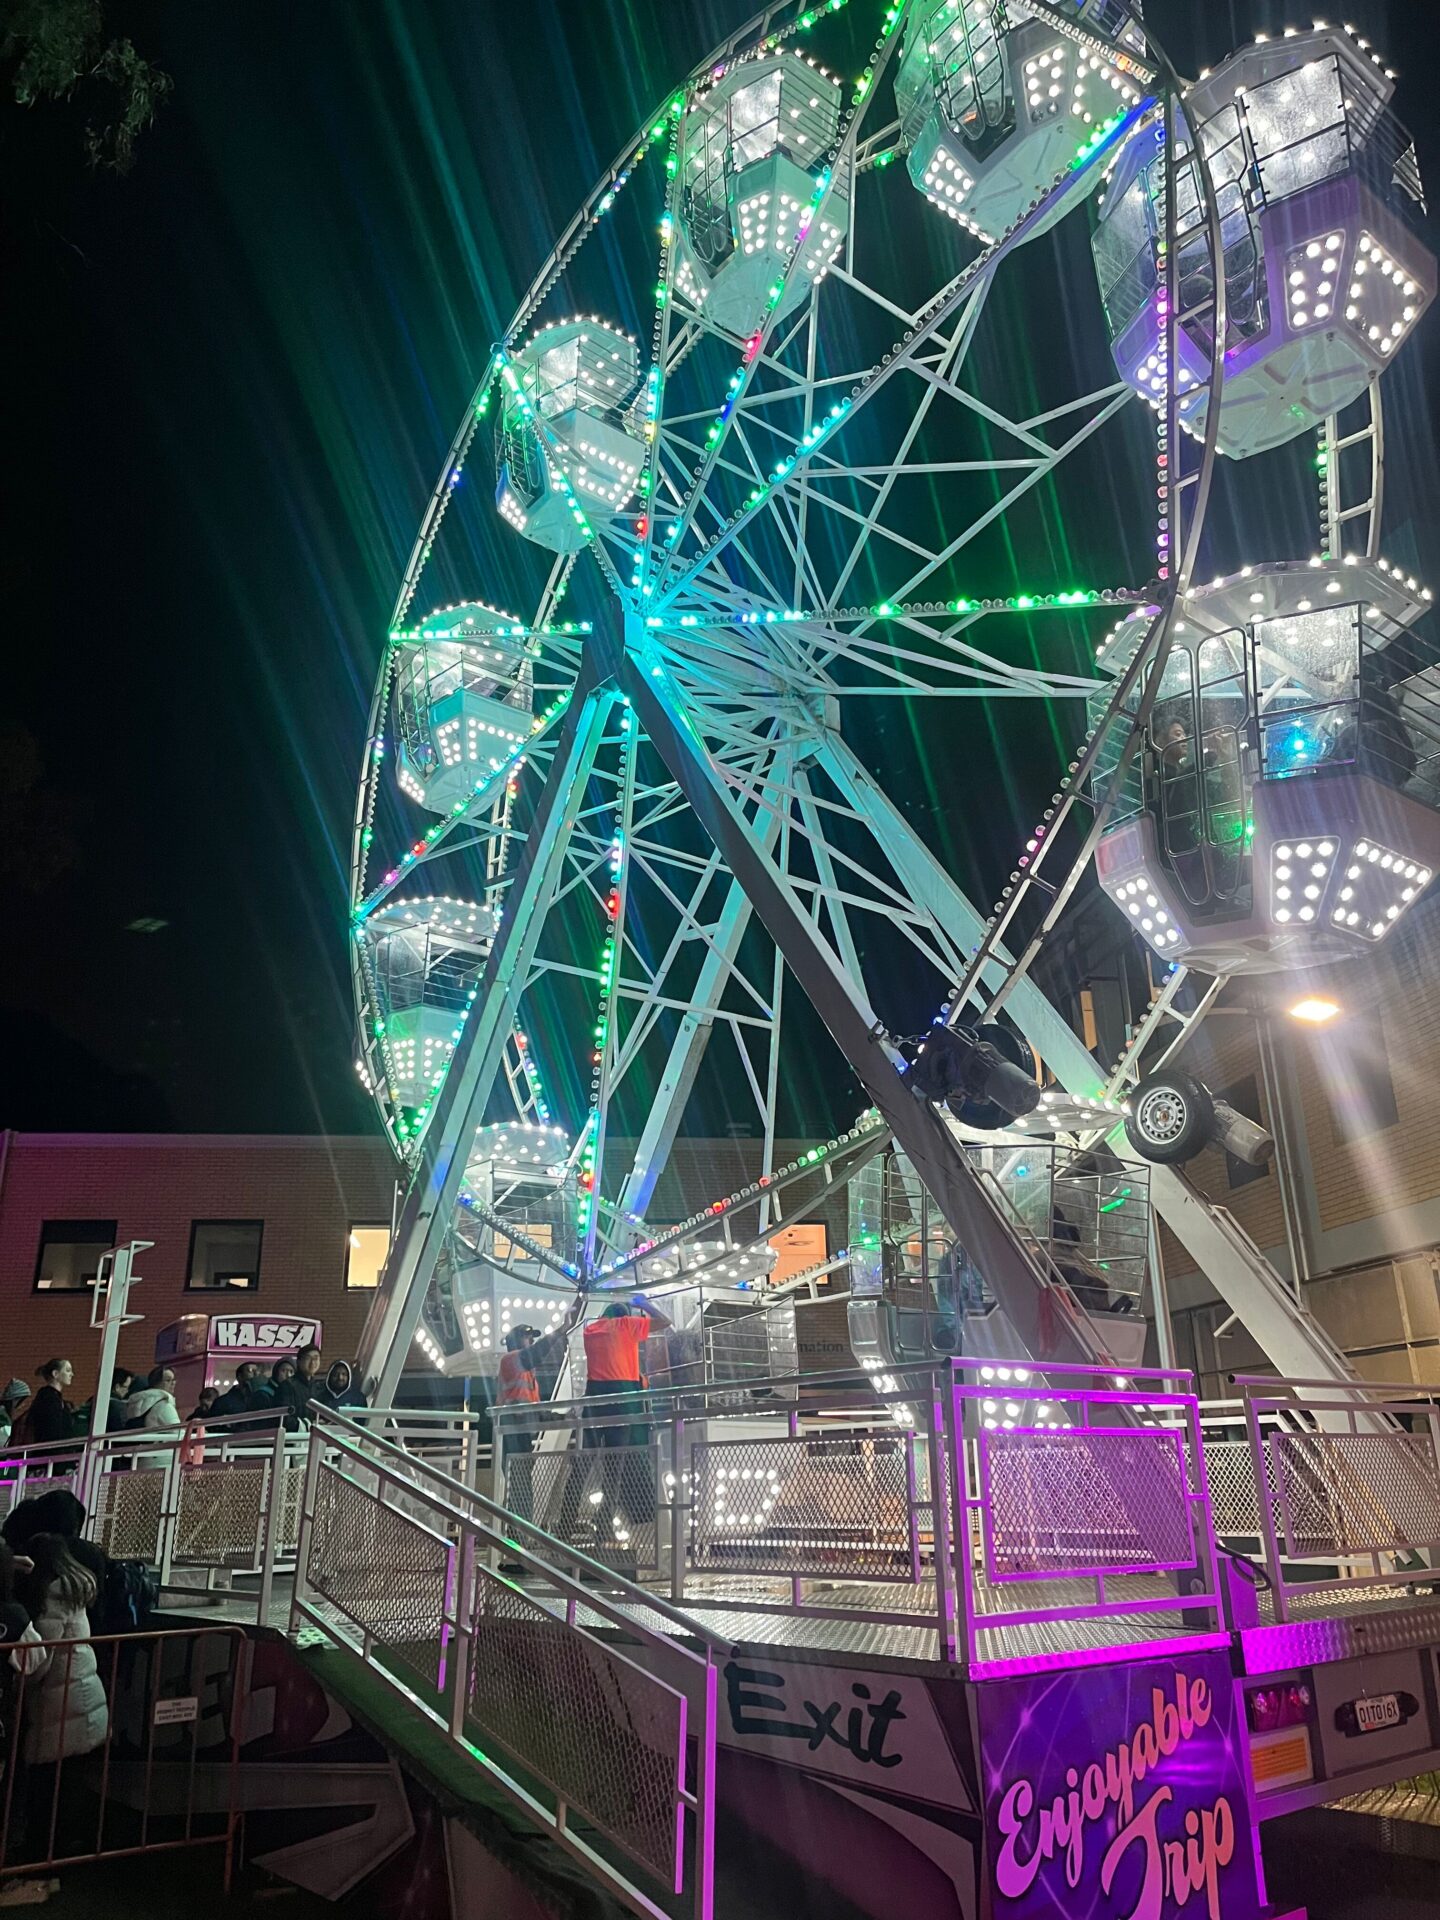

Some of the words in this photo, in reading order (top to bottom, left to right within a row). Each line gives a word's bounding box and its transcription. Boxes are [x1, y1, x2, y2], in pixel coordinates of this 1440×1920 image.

[217, 1322, 315, 1348] KASSA
[724, 1662, 906, 1768] Exit
[996, 1673, 1212, 1898] Enjoyable
[1101, 1786, 1234, 1920] Trip
